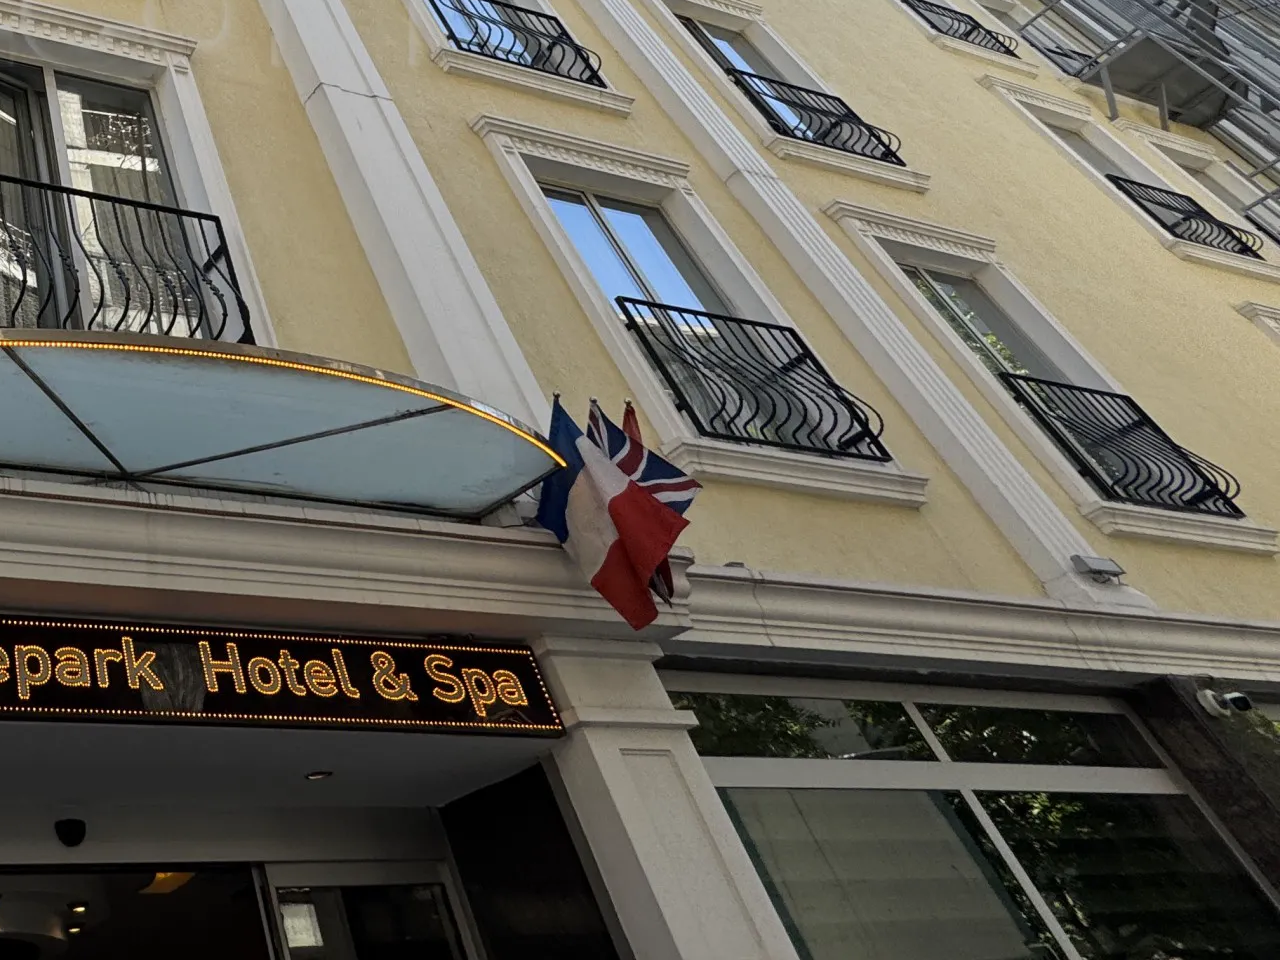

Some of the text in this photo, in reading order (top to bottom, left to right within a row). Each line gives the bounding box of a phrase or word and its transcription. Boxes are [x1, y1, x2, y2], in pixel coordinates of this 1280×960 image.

[197, 639, 361, 700] Hotel
[369, 649, 419, 702] &
[422, 653, 530, 719] Spa
